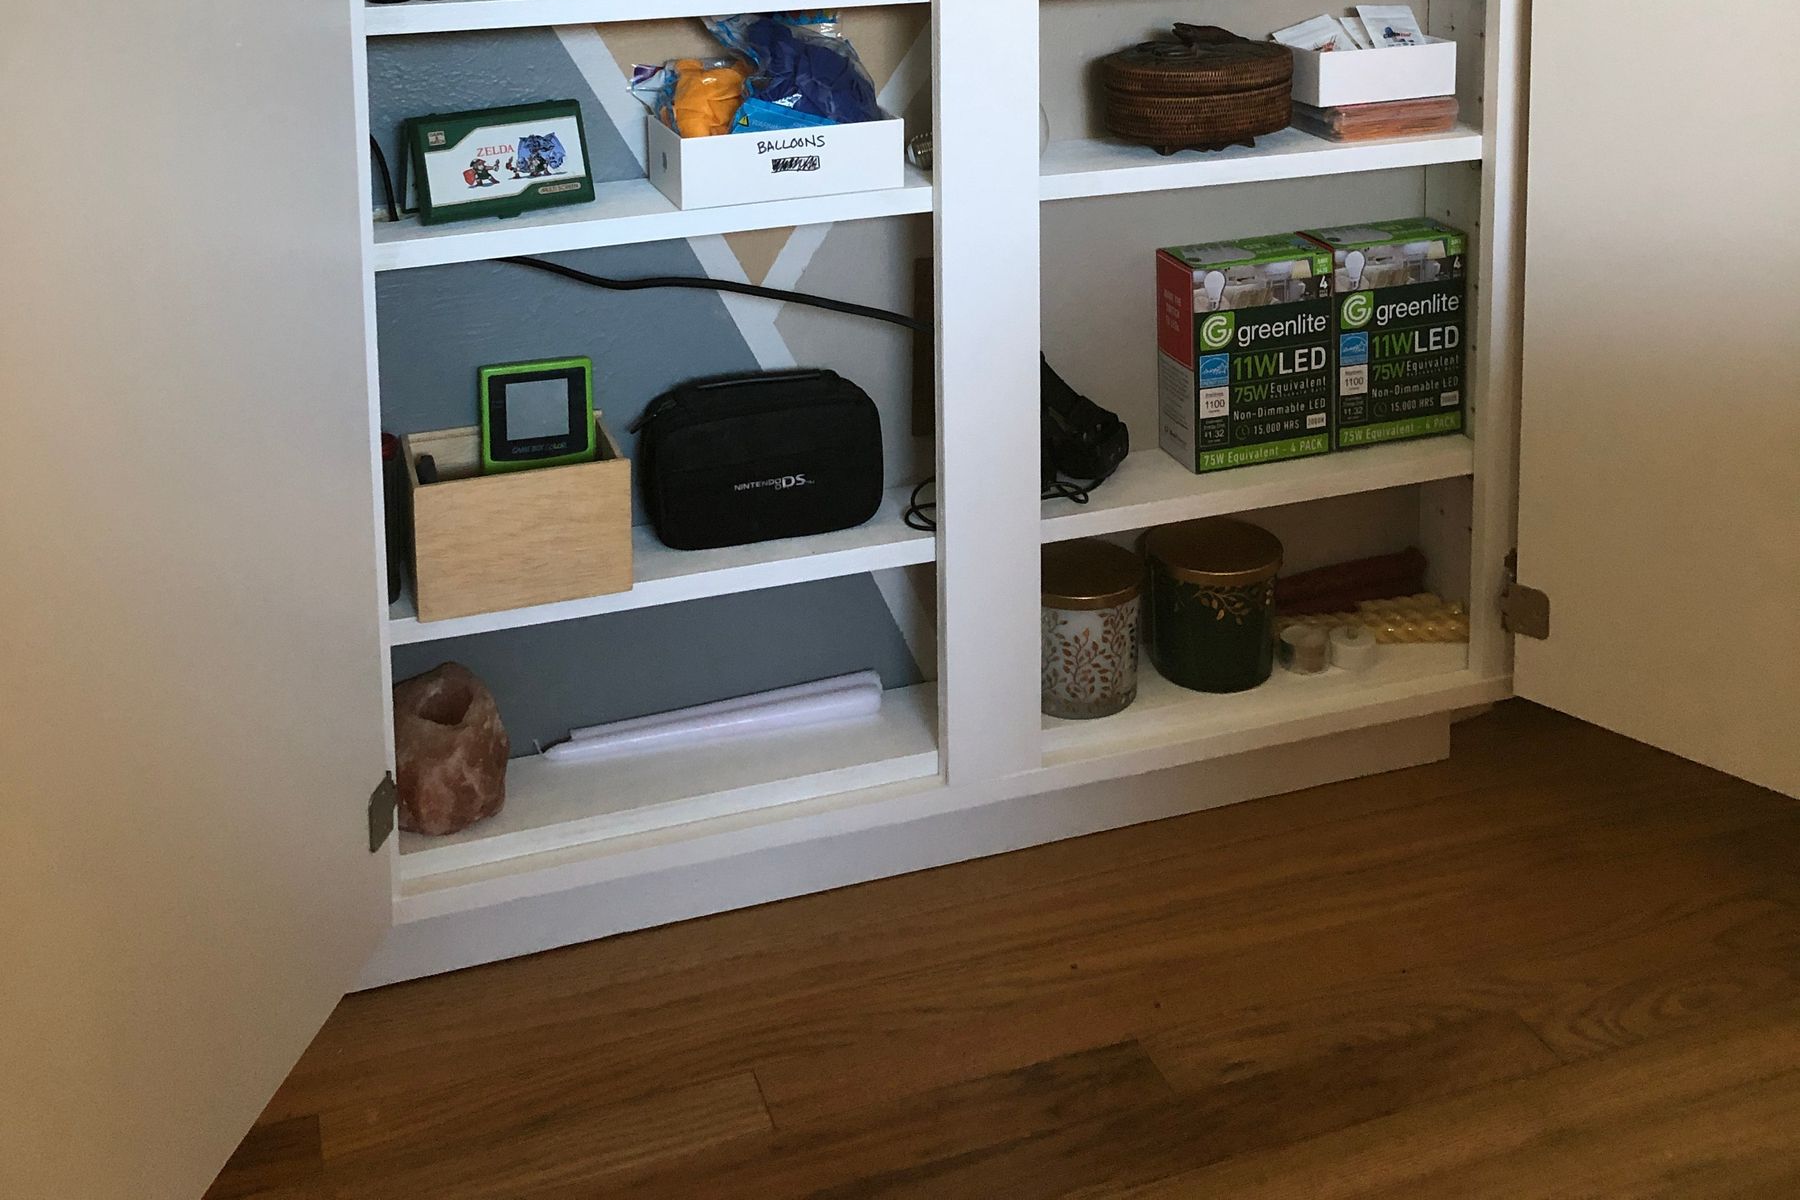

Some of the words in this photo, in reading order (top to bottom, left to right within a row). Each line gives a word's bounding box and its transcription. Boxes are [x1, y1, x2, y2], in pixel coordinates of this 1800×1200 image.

[476, 144, 515, 157] ZELDA
[757, 134, 826, 154] BALLOONS
[1319, 275, 1328, 289] 4
[1376, 293, 1459, 326] greenlite
[1237, 313, 1326, 347] greenlite
[1372, 362, 1406, 381] 75W
[1406, 355, 1459, 375] Equivalent
[1234, 383, 1269, 403] 75W
[1270, 376, 1326, 394] Equivalent
[1371, 380, 1439, 399] Non-Dimmable
[1205, 399, 1226, 409] 1100
[1233, 403, 1306, 422] Non-Dimmable
[1309, 397, 1326, 411] LED
[1283, 419, 1300, 430] HRS
[1366, 424, 1414, 440] Equivalent
[1204, 454, 1225, 467] 75W
[1228, 446, 1279, 463] Equivalent
[1300, 439, 1323, 451] PACK
[733, 478, 782, 491] NINTENDO
[782, 473, 807, 488] DS
